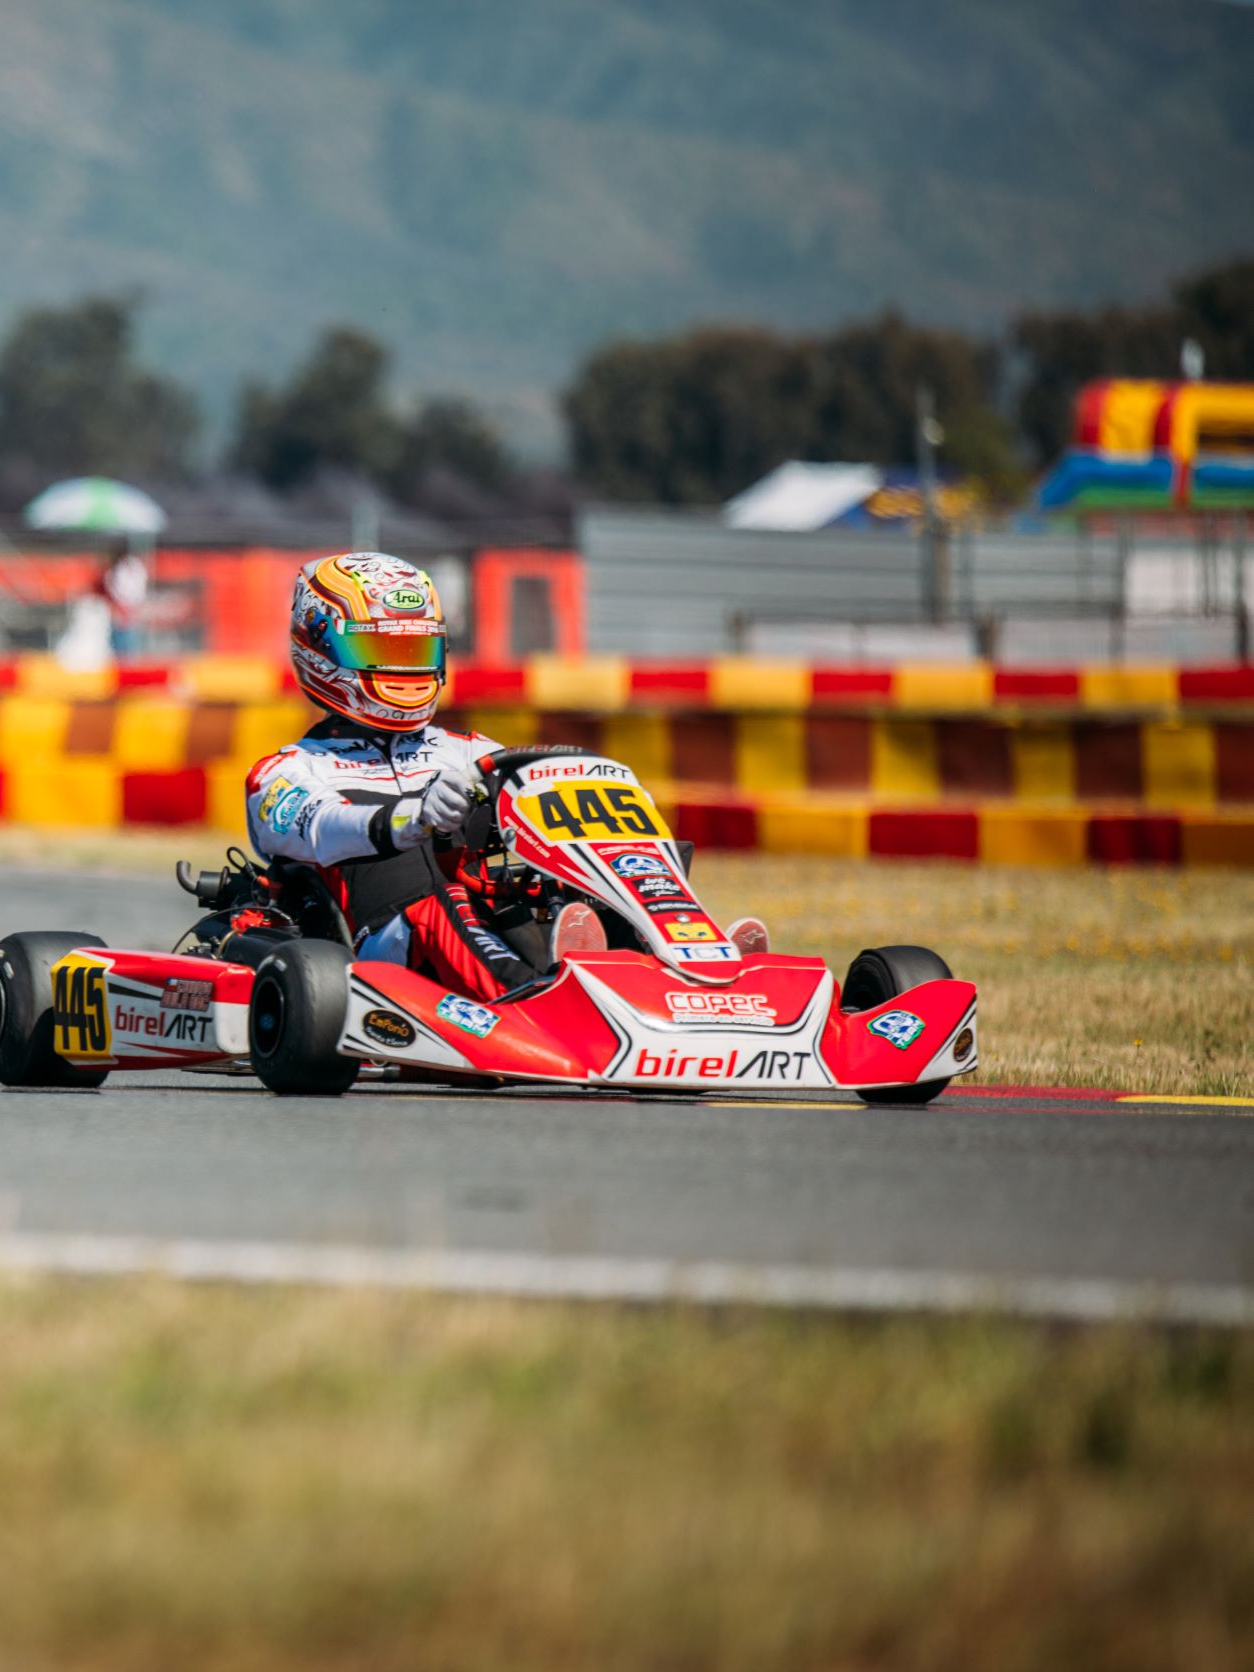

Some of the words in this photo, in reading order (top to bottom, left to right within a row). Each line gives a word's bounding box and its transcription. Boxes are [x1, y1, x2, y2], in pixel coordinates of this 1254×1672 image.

[394, 592, 420, 603] Arai
[529, 764, 630, 781] birelART
[538, 788, 659, 838] 445
[674, 946, 731, 959] TCT
[54, 966, 107, 1051] 445
[665, 992, 777, 1016] COPEC
[115, 1004, 213, 1043] birelART
[634, 1048, 812, 1081] birelART
